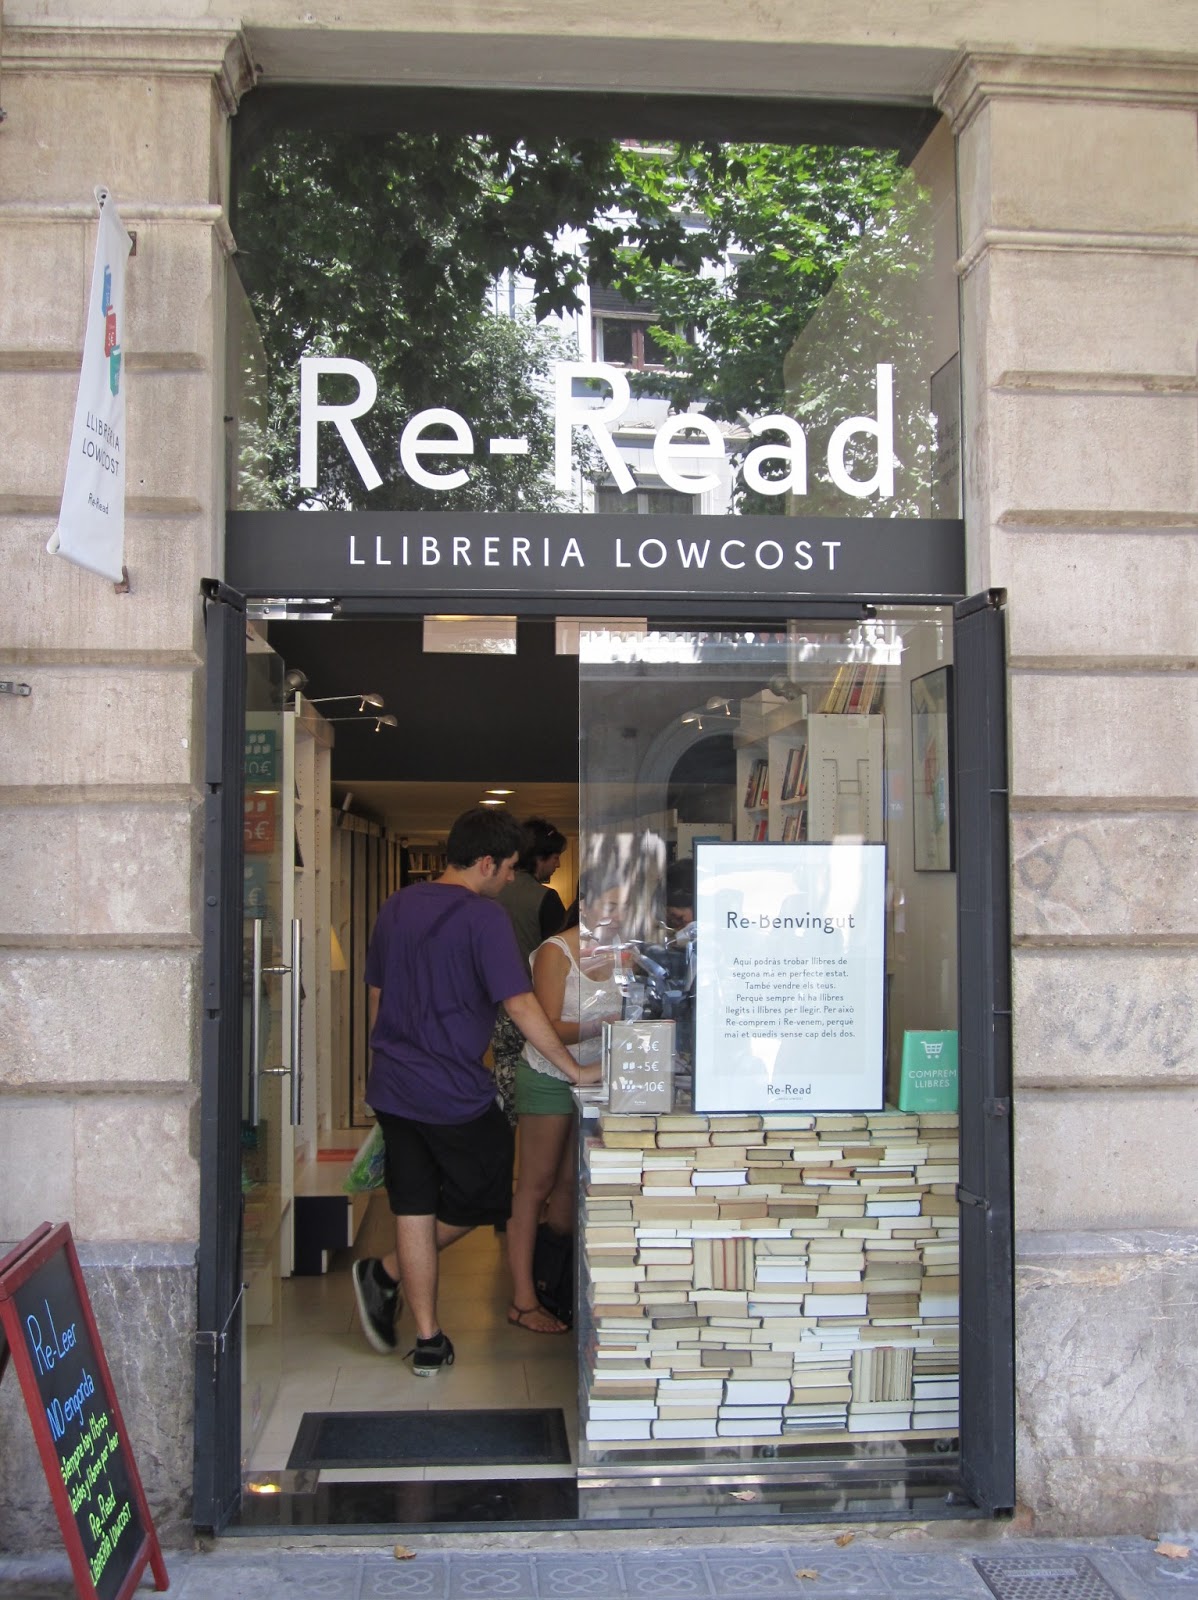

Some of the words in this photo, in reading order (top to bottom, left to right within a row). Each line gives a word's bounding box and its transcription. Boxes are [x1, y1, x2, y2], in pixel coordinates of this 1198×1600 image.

[86, 411, 120, 452] LLIBRERIA
[299, 357, 896, 498] Re-Read
[82, 437, 120, 476] LOWCOST
[88, 492, 109, 515] Re-Read
[349, 535, 586, 568] LLIBRERIA
[615, 538, 842, 572] LOWCOST
[727, 911, 855, 934] Re-Benvingut
[733, 957, 752, 967] Aquí
[783, 957, 809, 965] trobar
[811, 956, 836, 965] llibres
[838, 956, 848, 965] de
[732, 971, 760, 979] segona
[789, 969, 824, 979] perfecte
[826, 969, 849, 977] estat.
[745, 981, 771, 989] També
[737, 993, 764, 1003] Perquè
[766, 995, 795, 1003] sempre
[798, 993, 806, 1001] hi
[808, 993, 817, 1001] ha
[820, 993, 844, 1001] llibres
[725, 1006, 750, 1015] llegits
[800, 1006, 821, 1015] llegir.
[824, 1005, 836, 1013] Per
[838, 1005, 854, 1013] això
[725, 1018, 776, 1027] Re-comprem
[783, 1018, 825, 1026] Re-venem,
[827, 1018, 854, 1027] perquè
[752, 1030, 778, 1038] quedis
[805, 1031, 819, 1039] cap
[644, 1061, 660, 1072] 5€
[908, 1070, 957, 1079] COMPREM
[644, 1081, 665, 1092] 10€
[915, 1079, 951, 1088] LLIBRES
[767, 1084, 812, 1095] Re-Read
[27, 1299, 77, 1375] Re-Leer
[46, 1397, 66, 1442] NO
[64, 1367, 95, 1426] engorda
[80, 1432, 95, 1456] hay
[89, 1412, 108, 1440] libros
[86, 1458, 102, 1483] libros
[100, 1445, 109, 1474] por
[106, 1432, 119, 1453] leer
[88, 1480, 117, 1541] Re-Read
